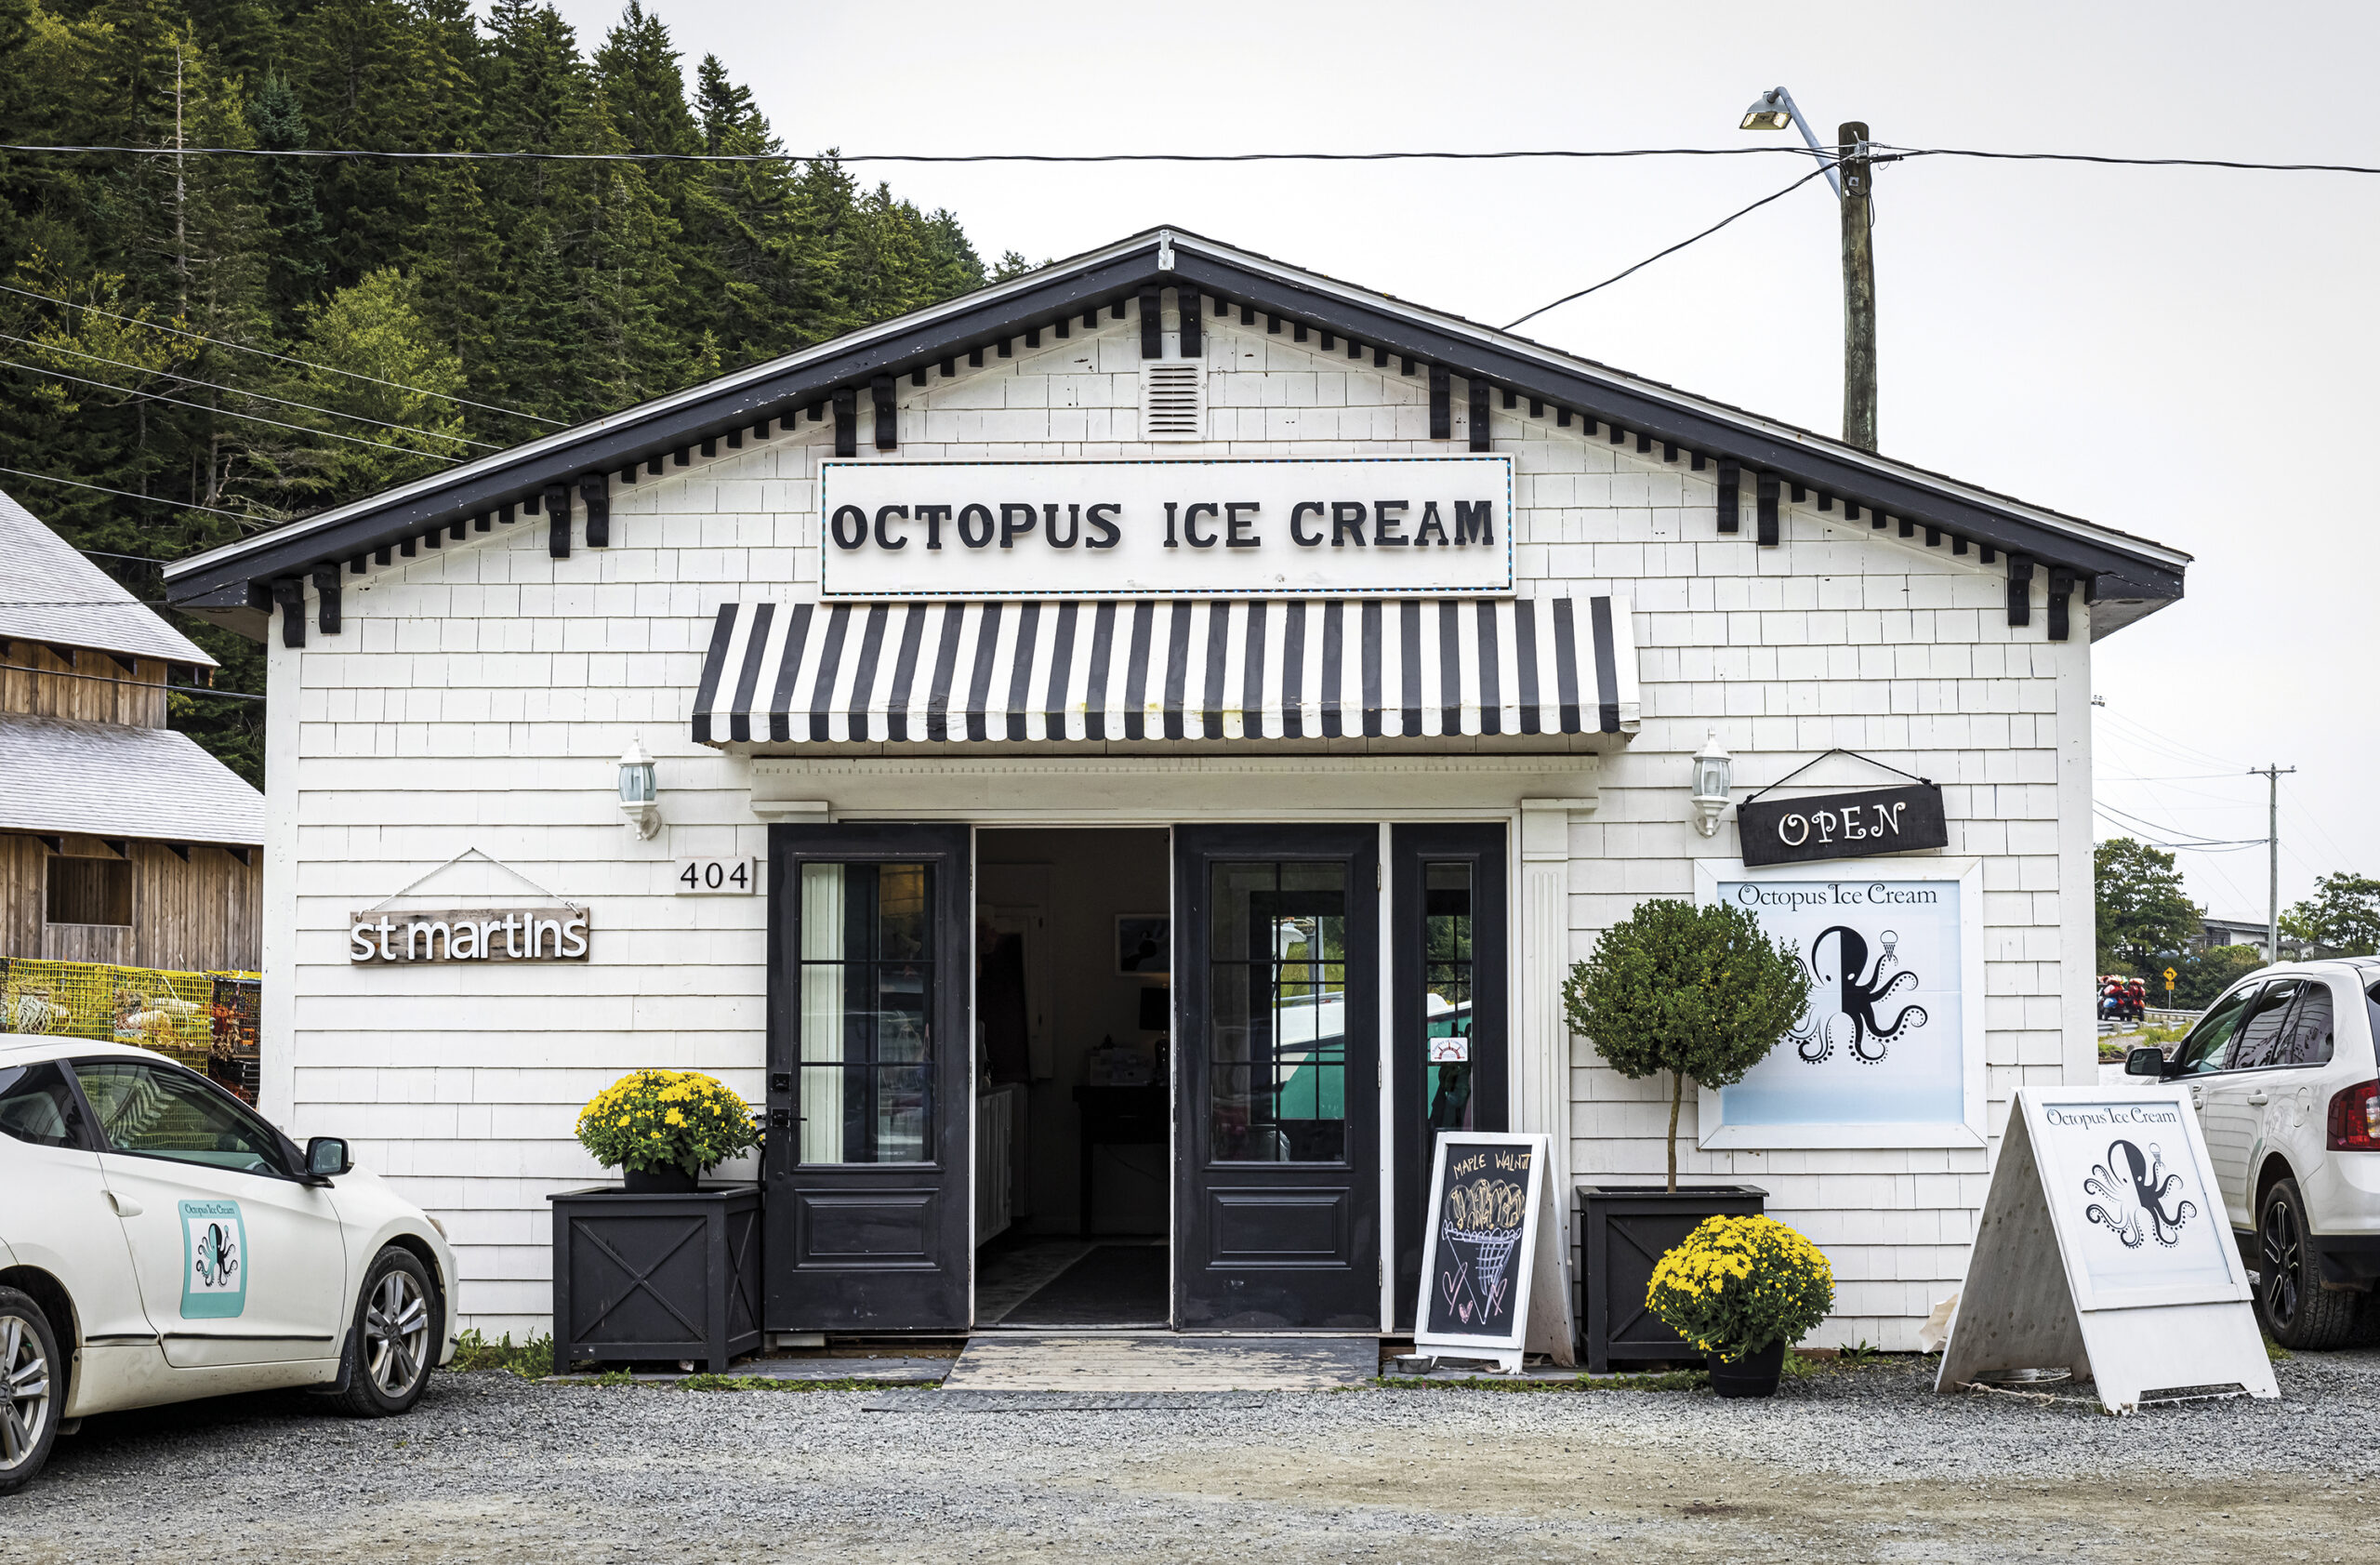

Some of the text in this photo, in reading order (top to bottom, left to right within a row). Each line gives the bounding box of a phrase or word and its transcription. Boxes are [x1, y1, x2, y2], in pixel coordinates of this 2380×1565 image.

[832, 500, 1494, 550] OCTOPUS ICE CREAM
[1778, 802, 1906, 846] OPEN
[680, 862, 748, 889] 404
[1738, 883, 1938, 912] Octopus Ice Cream
[350, 912, 588, 962] st martins
[2046, 1107, 2177, 1130] Octopus Ice Cream
[1452, 1153, 1487, 1180] MAPLE
